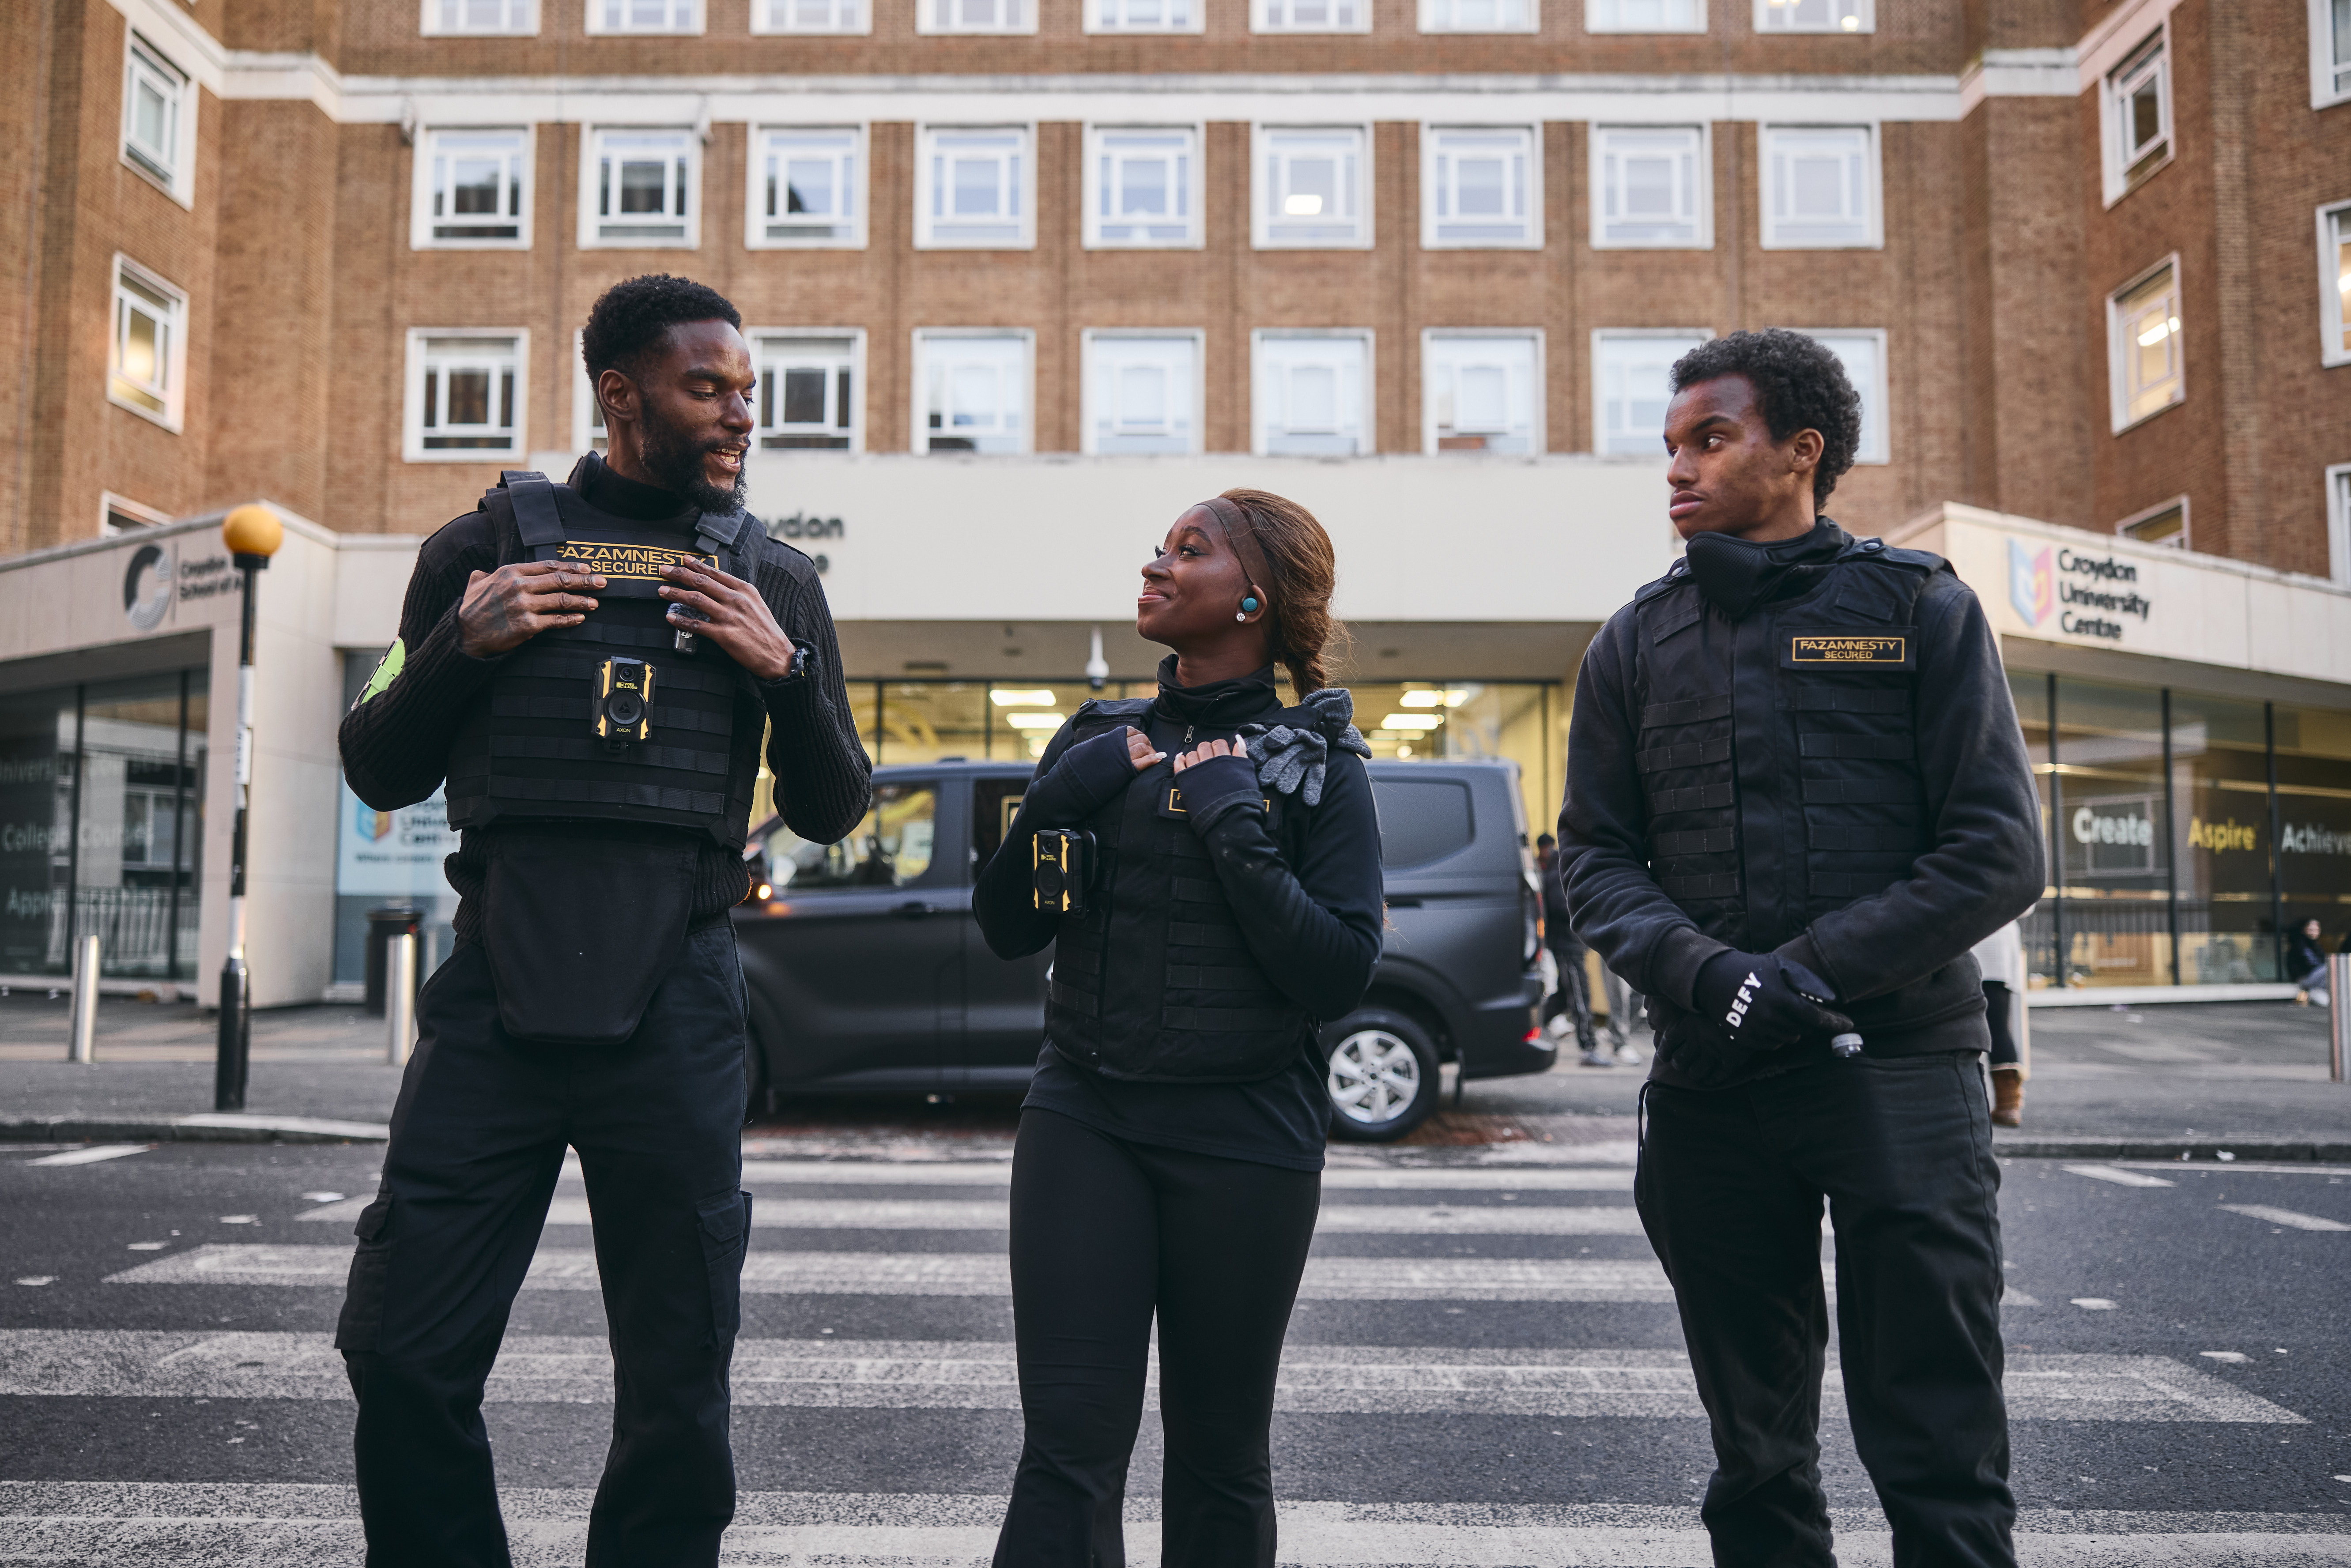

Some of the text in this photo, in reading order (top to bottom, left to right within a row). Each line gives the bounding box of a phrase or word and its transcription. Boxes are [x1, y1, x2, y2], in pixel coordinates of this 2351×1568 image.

[762, 512, 844, 539] ydon
[591, 561, 661, 575] SECURE
[2059, 549, 2136, 581] Croydon
[2060, 581, 2150, 621] University
[2062, 611, 2121, 639] Centre
[1800, 641, 1897, 650] FAZAMNESTY
[1824, 651, 1873, 659] SECURED
[2073, 807, 2153, 846] Create
[2187, 816, 2257, 854] Aspire
[1725, 972, 1761, 1027] DEFY
